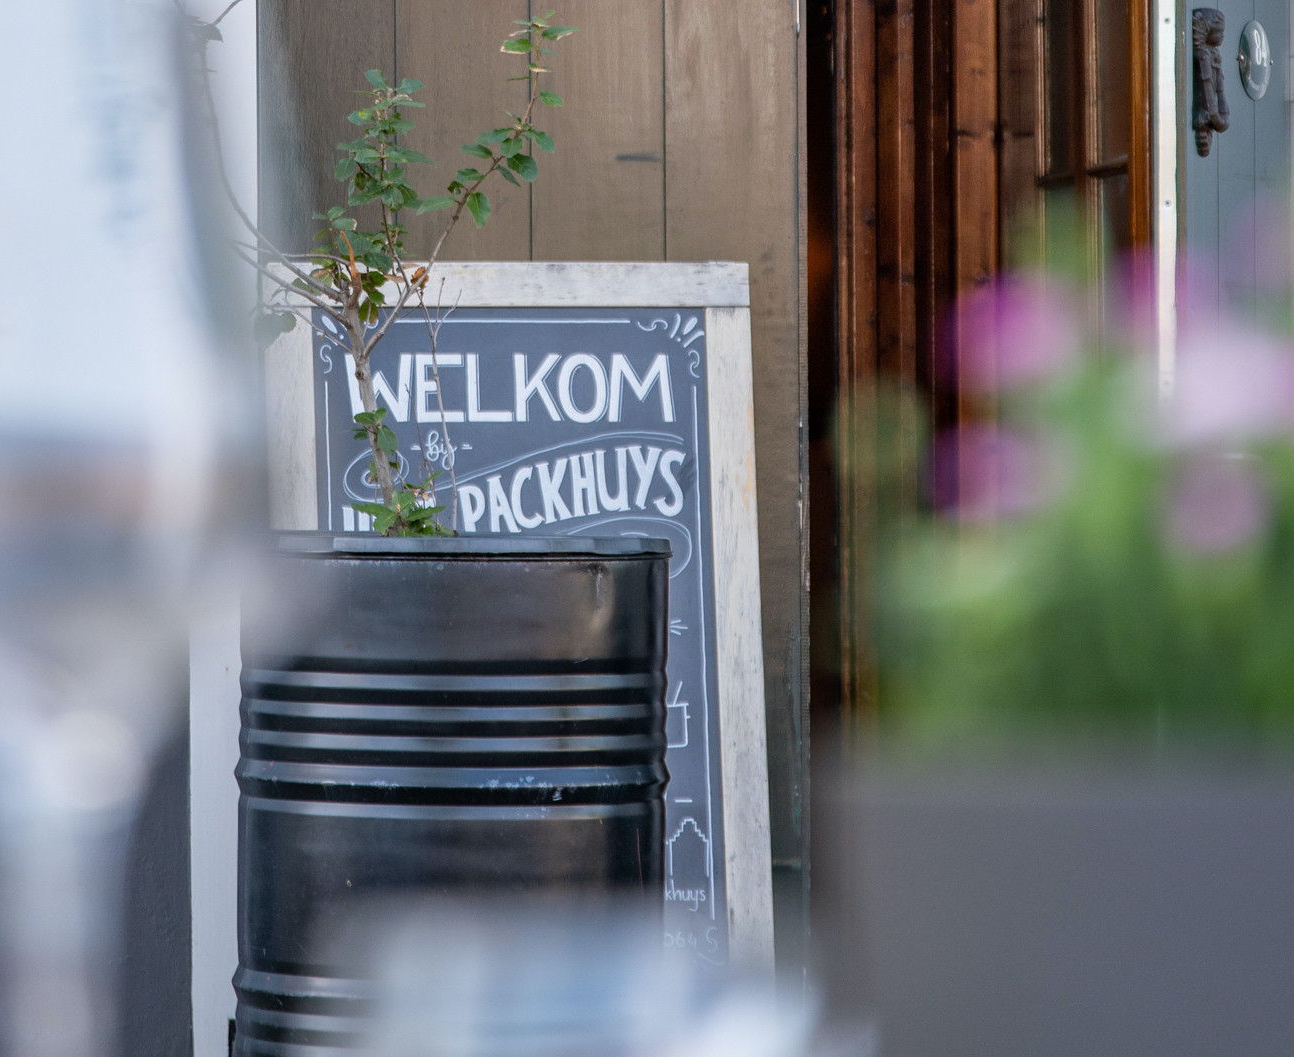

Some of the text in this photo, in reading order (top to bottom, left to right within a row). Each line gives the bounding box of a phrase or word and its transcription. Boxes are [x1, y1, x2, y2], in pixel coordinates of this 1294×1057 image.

[1253, 28, 1268, 67] 84
[344, 352, 677, 423] WELKOM
[457, 445, 687, 533] PACKHUYS
[664, 878, 707, 912] khuys
